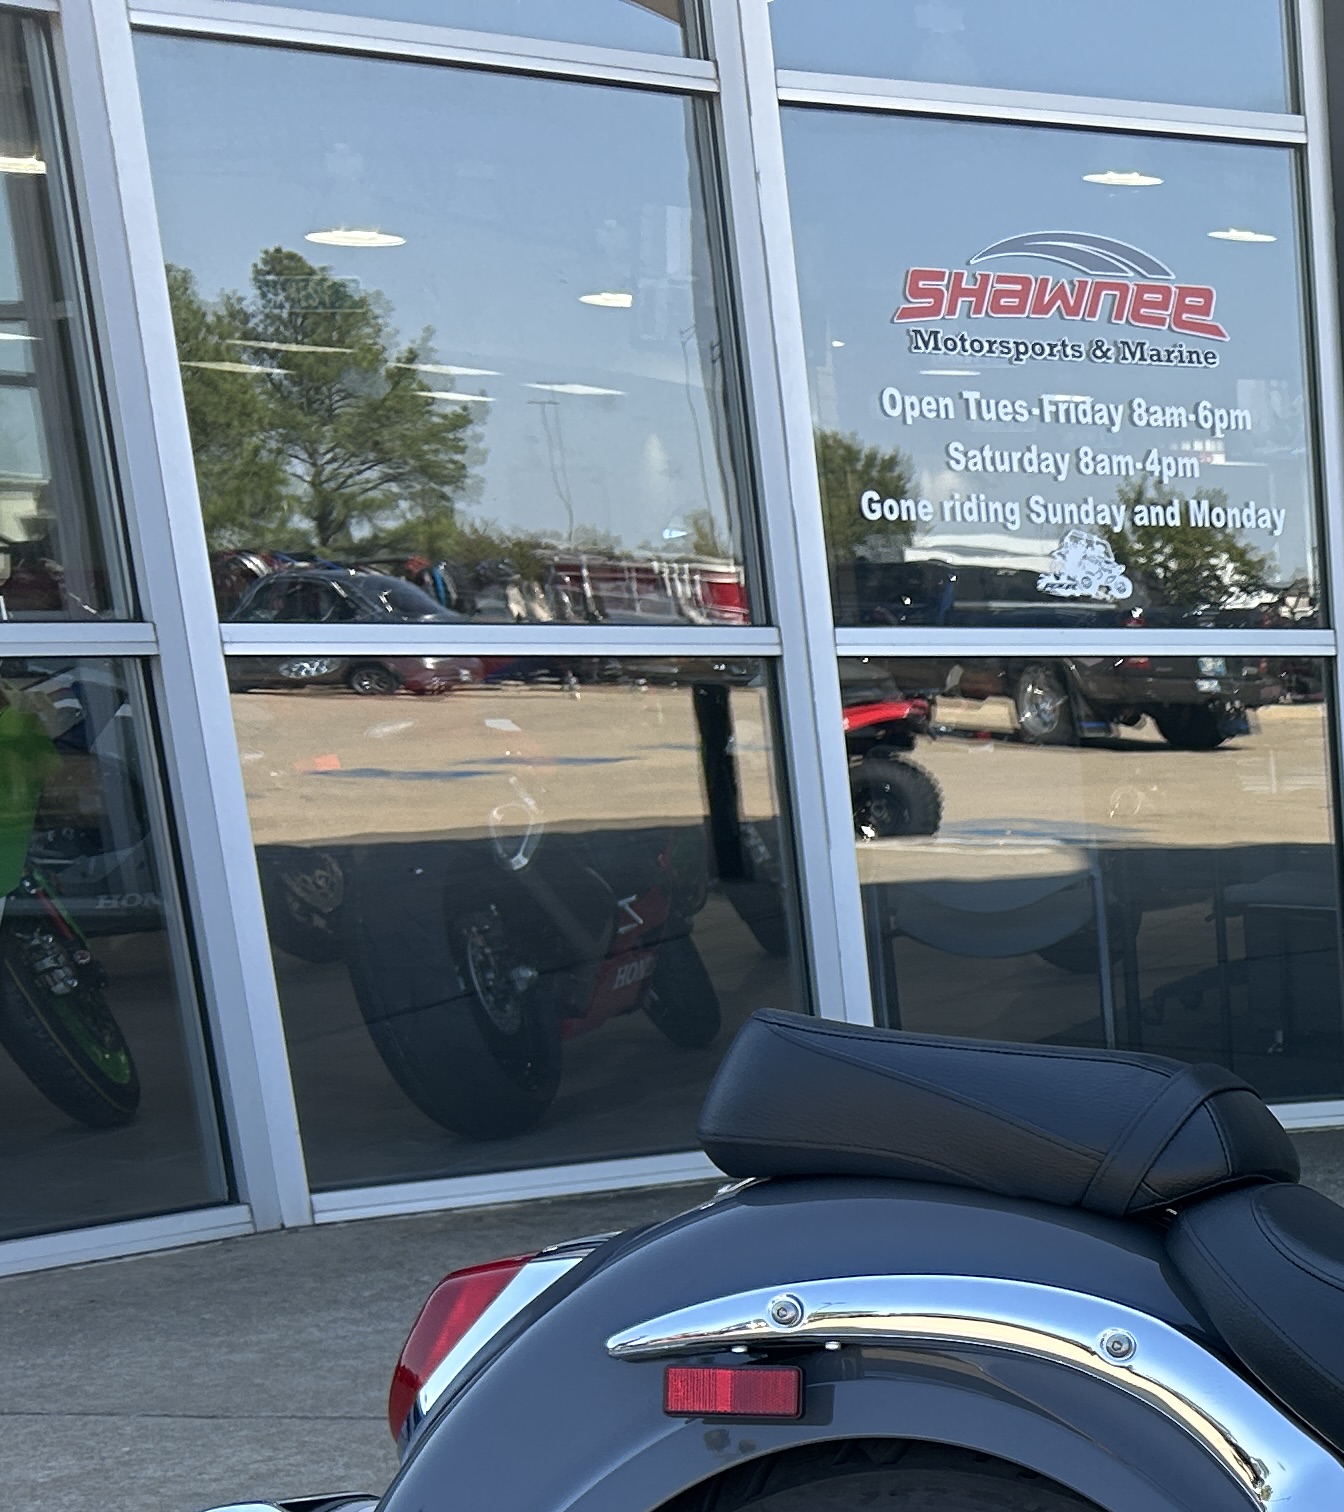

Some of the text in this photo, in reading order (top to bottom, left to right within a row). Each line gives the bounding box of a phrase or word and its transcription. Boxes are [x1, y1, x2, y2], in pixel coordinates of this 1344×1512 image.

[911, 329, 1218, 366] Motorsports & Marine
[881, 387, 1251, 436] Open Tues-Friday 8am-6pm
[947, 442, 1200, 483] Saturday 8am-4pm
[861, 490, 1285, 535] Gone riding Sunday and Monday
